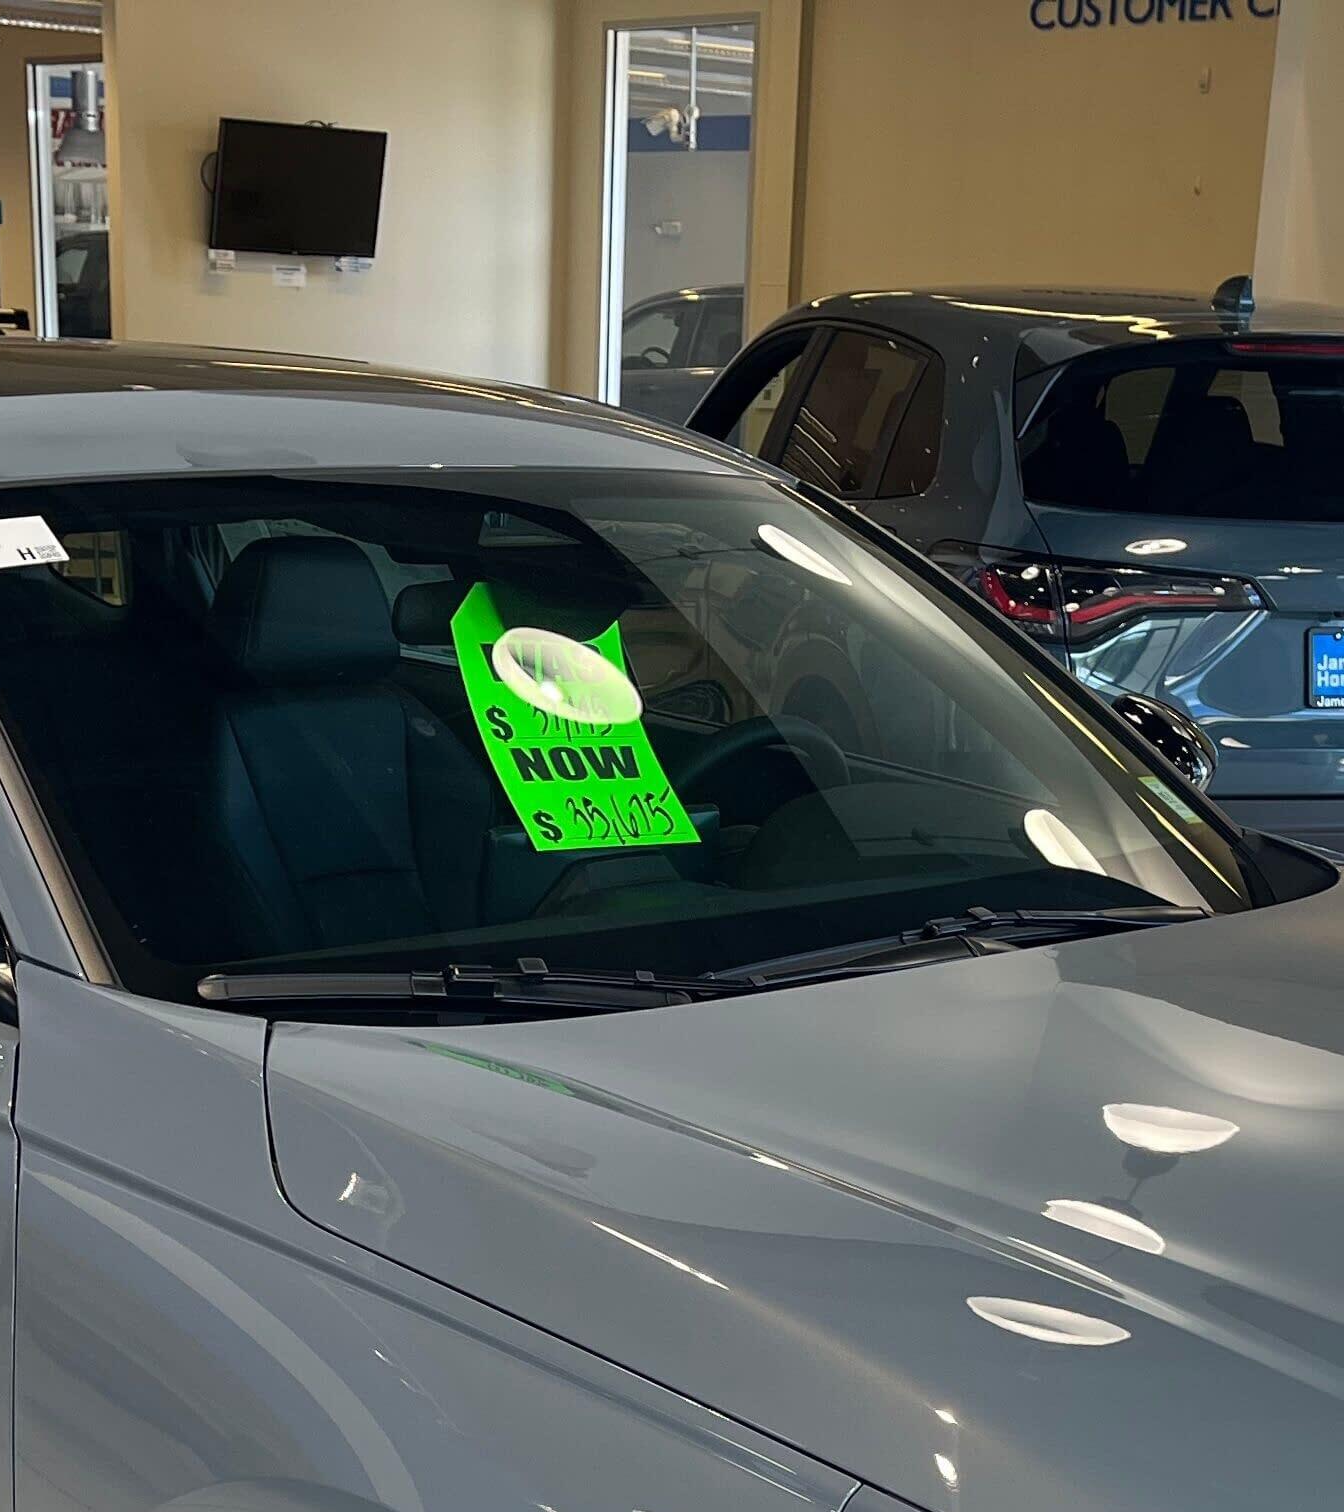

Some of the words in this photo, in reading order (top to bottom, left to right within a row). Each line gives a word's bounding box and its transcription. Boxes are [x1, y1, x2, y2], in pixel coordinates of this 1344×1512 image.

[485, 705, 514, 743] $
[509, 745, 641, 782] NOW
[533, 810, 564, 844] $
